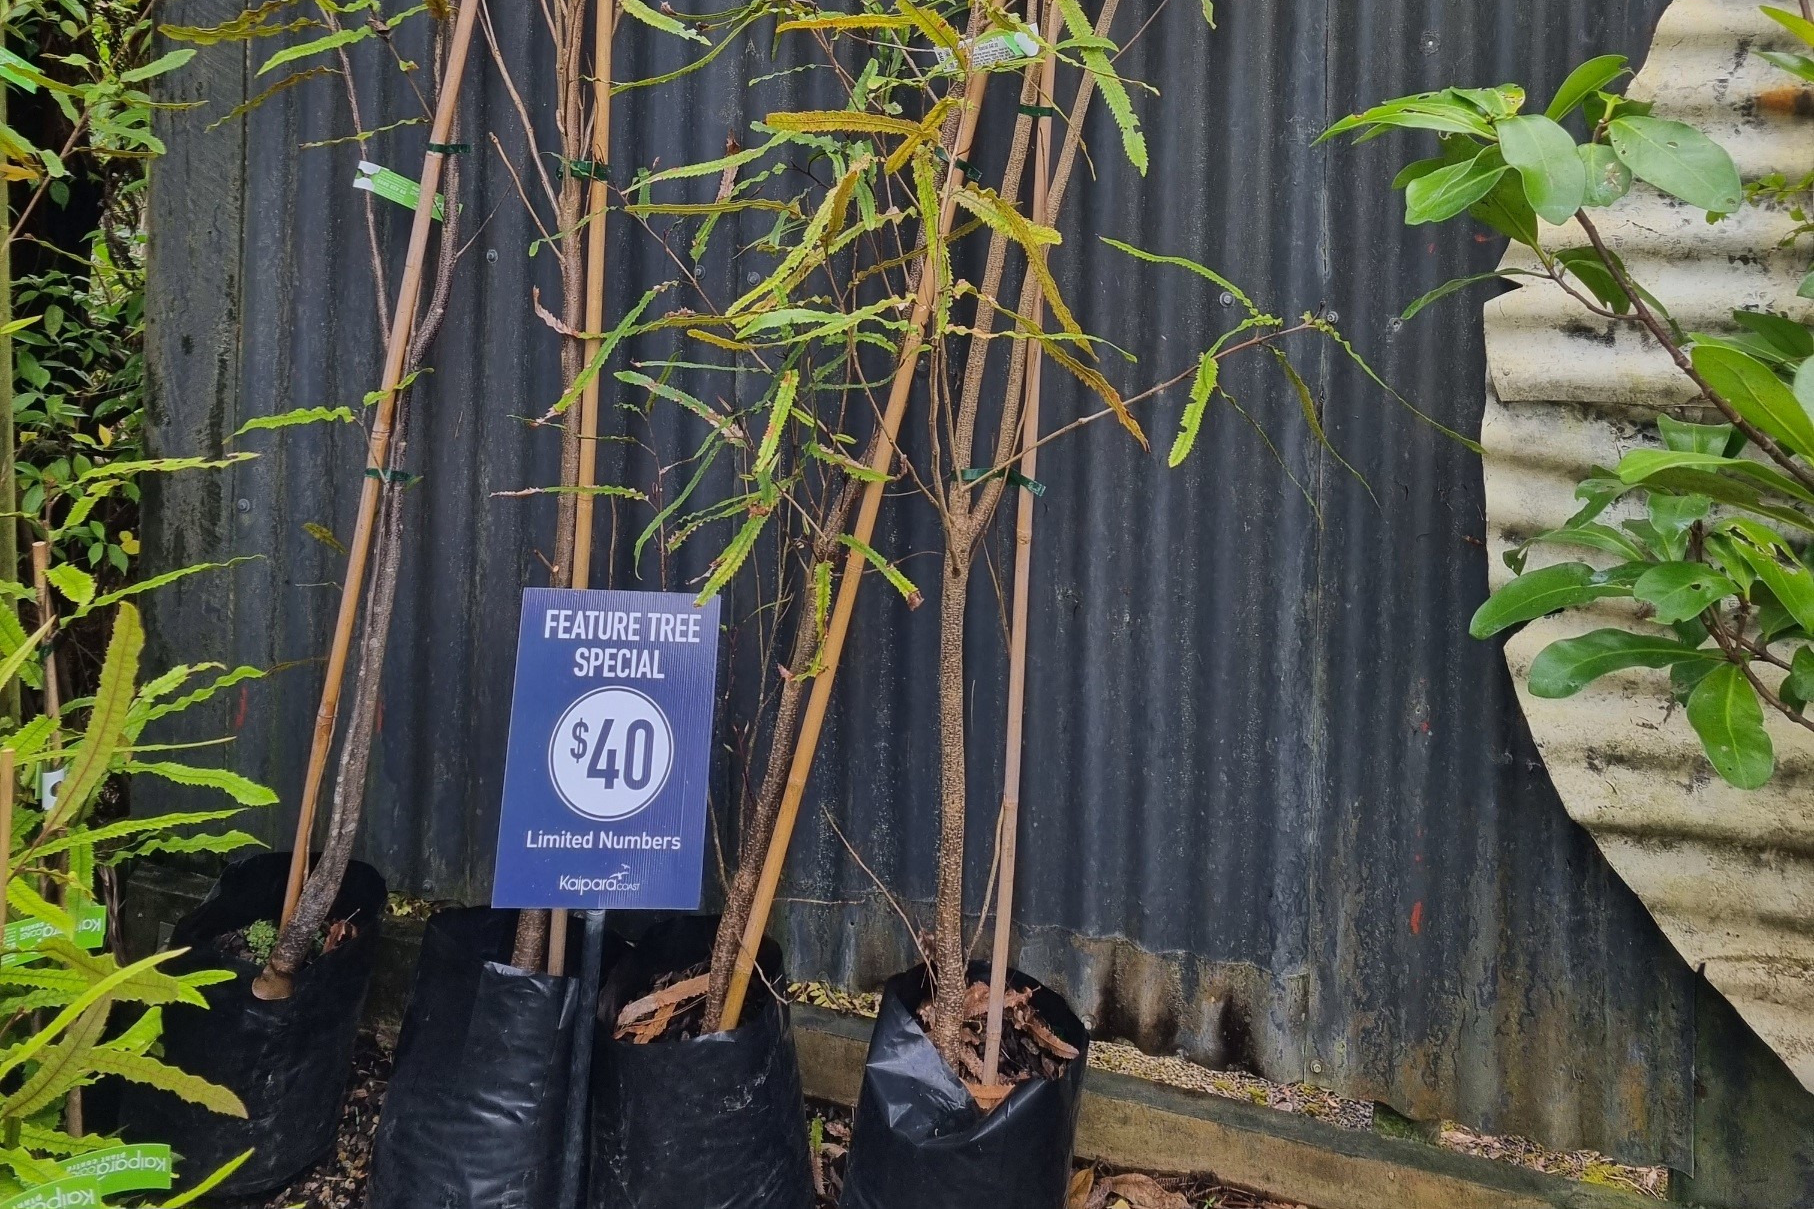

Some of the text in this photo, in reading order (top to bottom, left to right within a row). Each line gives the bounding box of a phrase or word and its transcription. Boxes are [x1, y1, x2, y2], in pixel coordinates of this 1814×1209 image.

[544, 609, 702, 643] FEATURE TREE
[573, 647, 665, 679] SPECIAL
[570, 717, 655, 791] $40
[526, 830, 681, 850] Limited Numbers
[559, 875, 617, 896] Kaipara
[96, 1150, 166, 1176] Kaipara
